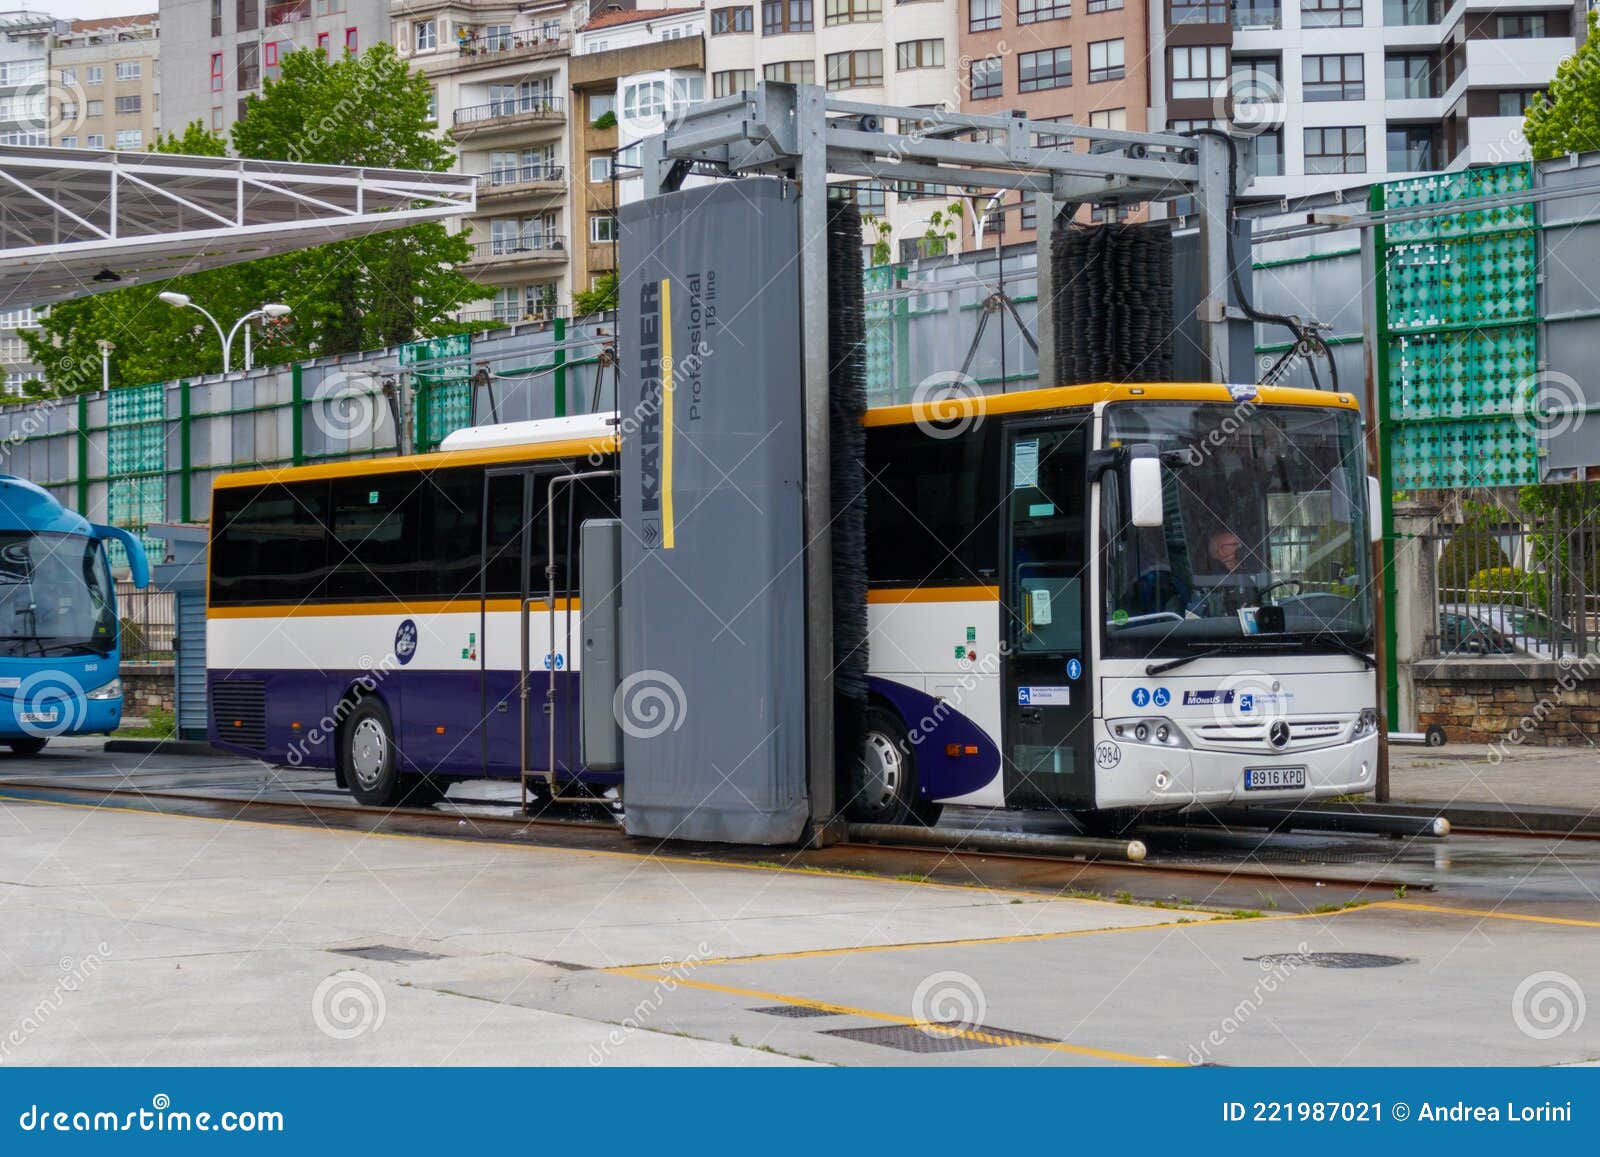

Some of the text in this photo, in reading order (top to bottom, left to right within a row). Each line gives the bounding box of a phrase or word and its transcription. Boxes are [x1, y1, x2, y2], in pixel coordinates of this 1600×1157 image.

[705, 271, 716, 300] line
[686, 272, 701, 421] Professional
[1252, 769, 1303, 785] 8916 KPD
